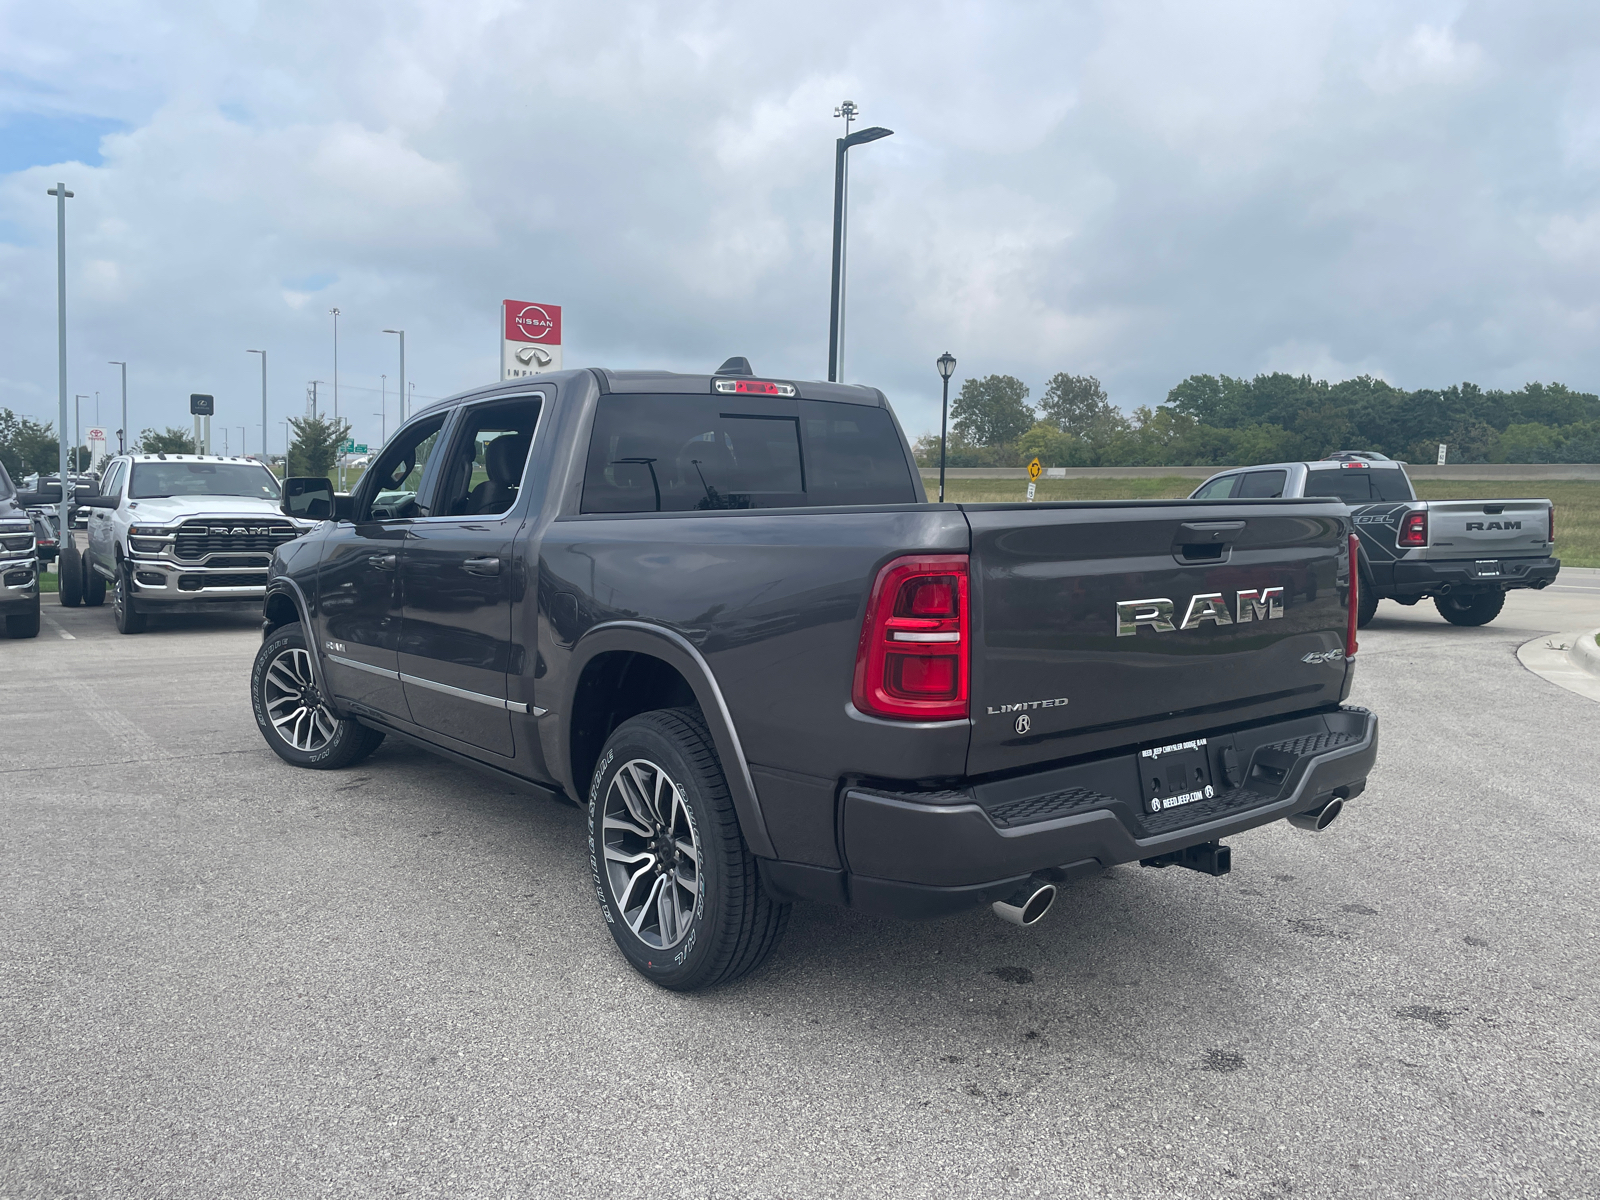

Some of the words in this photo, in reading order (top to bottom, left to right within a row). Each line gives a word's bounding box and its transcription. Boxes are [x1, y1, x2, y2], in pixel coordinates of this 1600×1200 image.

[515, 317, 553, 328] NISSAN
[507, 369, 542, 377] INFI
[1352, 515, 1394, 525] EBEL
[209, 526, 269, 536] RAM
[1466, 521, 1522, 531] RAM
[1116, 586, 1285, 638] RAM
[986, 697, 1069, 714] LIMITED
[1141, 749, 1153, 757] REED
[1153, 746, 1162, 755] JEEP
[1163, 743, 1183, 753] CHRYSLER
[1183, 740, 1196, 749] DODGE
[1196, 738, 1207, 746] RAM
[1163, 791, 1203, 808] REEDJEEP.COM
